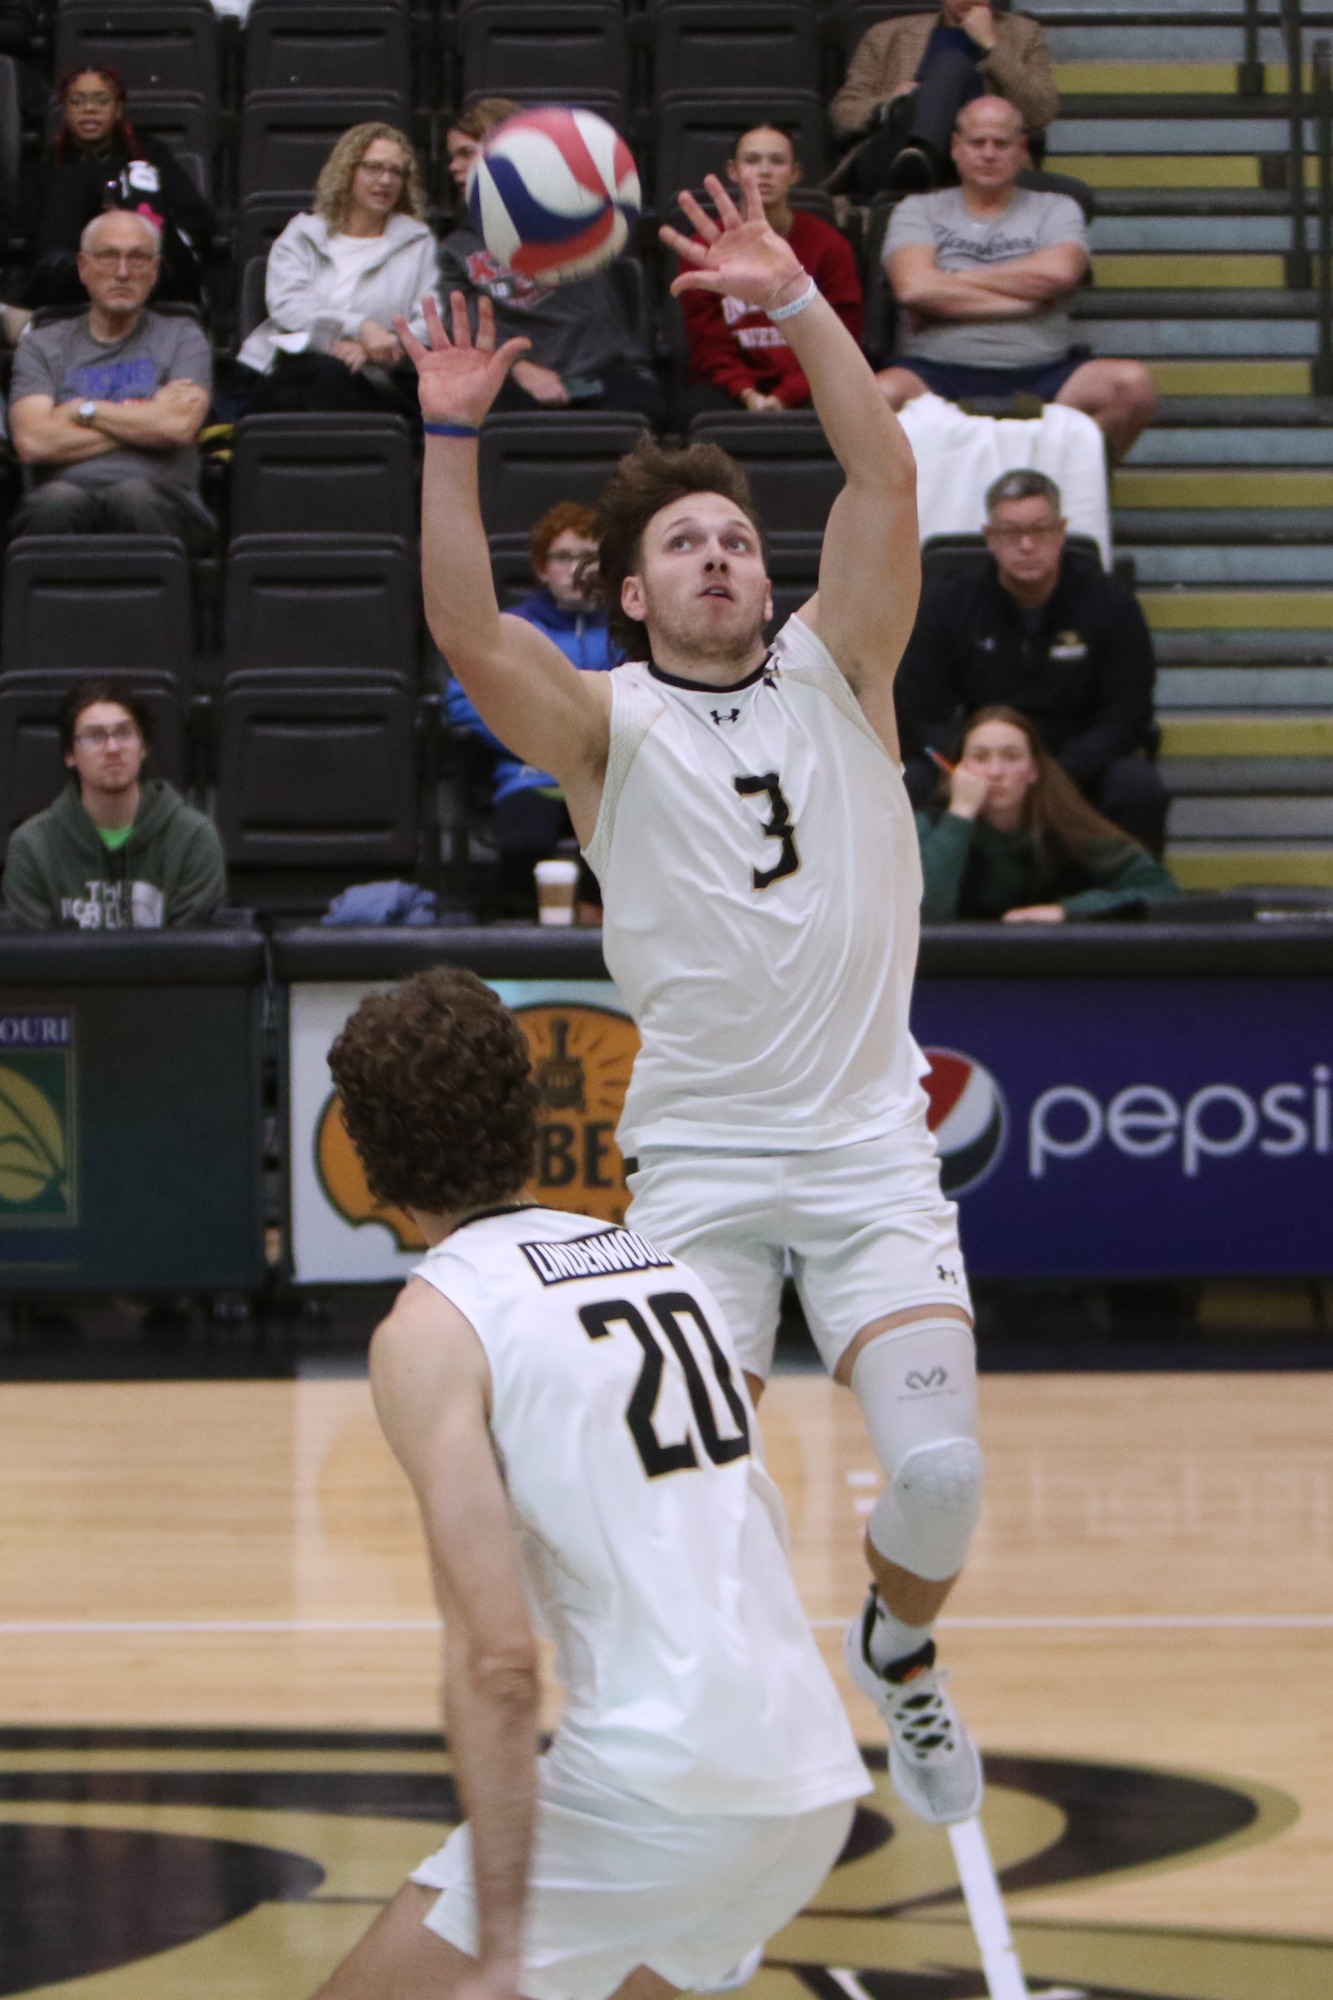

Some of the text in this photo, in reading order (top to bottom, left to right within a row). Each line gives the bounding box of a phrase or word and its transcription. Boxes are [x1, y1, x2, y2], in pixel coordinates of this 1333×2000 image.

[732, 771, 801, 890] 3
[538, 1122, 640, 1188] BE
[1028, 1064, 1332, 1179] pepsi
[576, 1290, 751, 1481] 20
